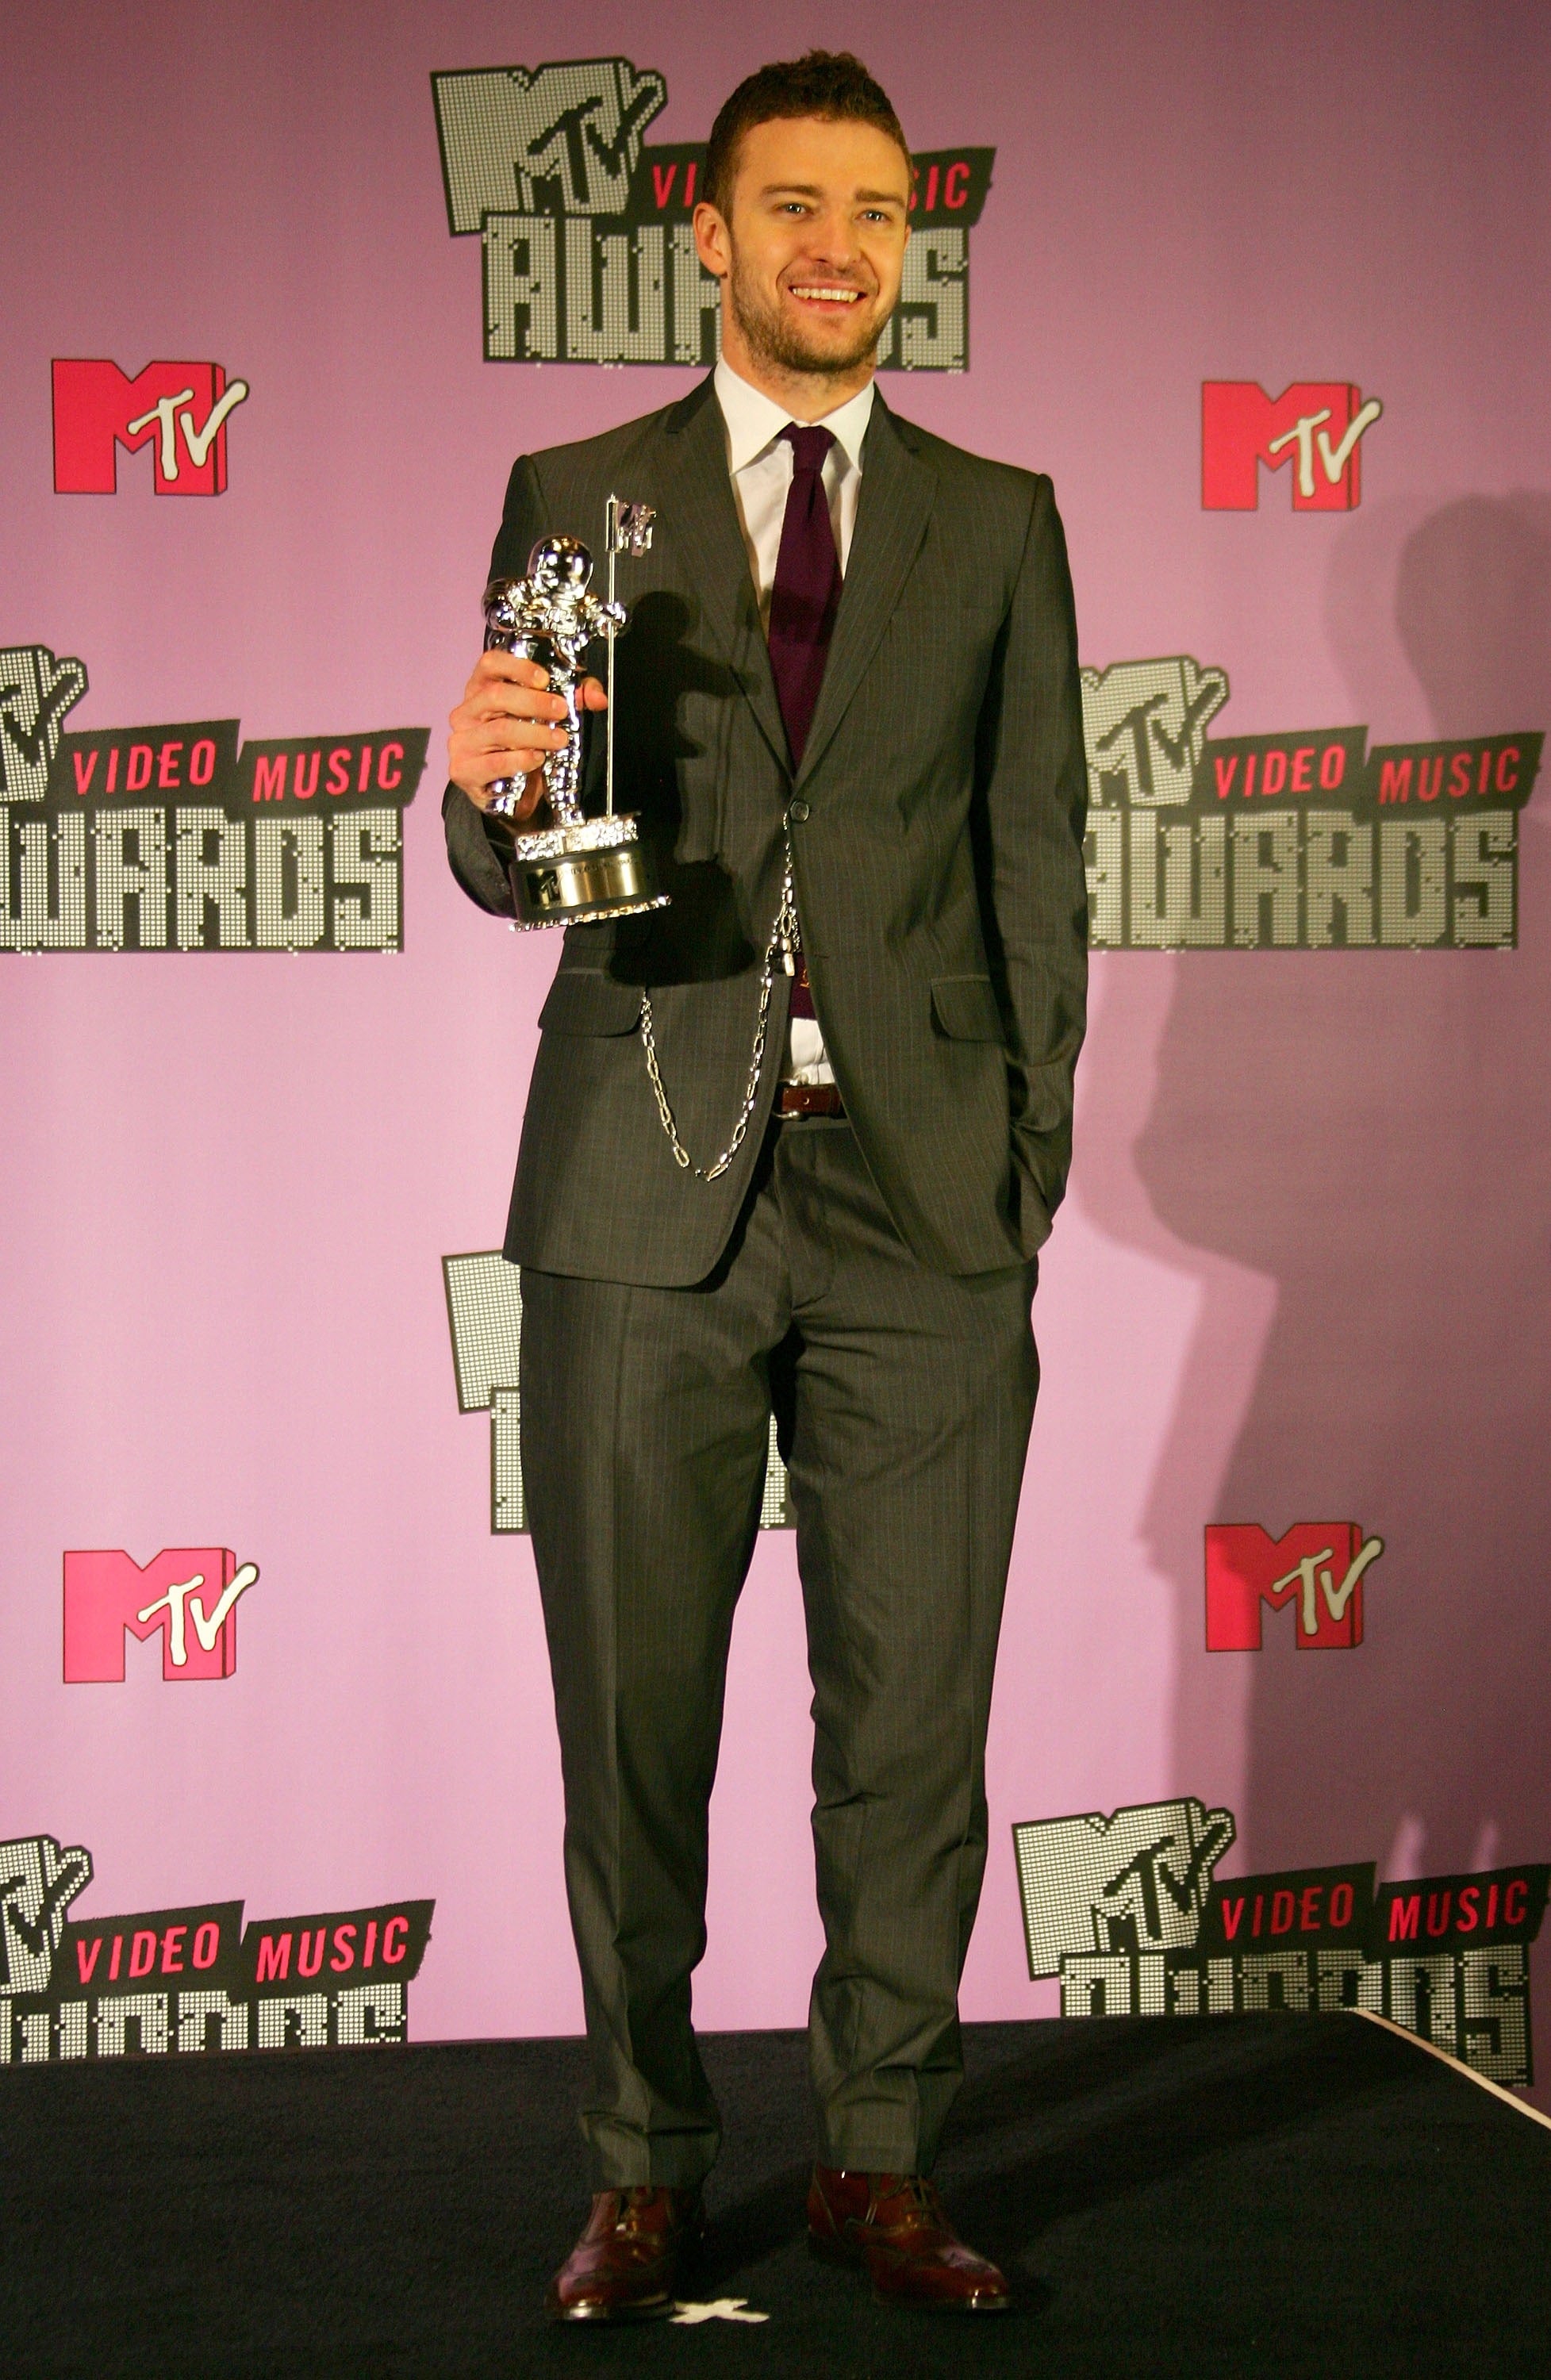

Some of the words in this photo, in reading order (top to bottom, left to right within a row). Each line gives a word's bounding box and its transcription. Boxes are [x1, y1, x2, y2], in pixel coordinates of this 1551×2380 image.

[431, 56, 667, 236] MTV
[52, 359, 248, 496] MTV
[1201, 381, 1383, 512] MTV
[73, 739, 217, 796] VIDEO
[252, 742, 405, 803] MUSIC
[1214, 744, 1346, 800] VIDEO
[1379, 747, 1521, 805] MUSIC
[0, 806, 401, 954] WARDS
[63, 1548, 259, 1683] MTV
[1204, 1522, 1384, 1652] MTV
[76, 1921, 220, 1984] VIDEO
[255, 1916, 409, 1983] MUSIC
[1012, 1797, 1237, 1981] MTV
[1222, 1883, 1354, 1940] VIDEO
[1388, 1879, 1529, 1943] MUSIC
